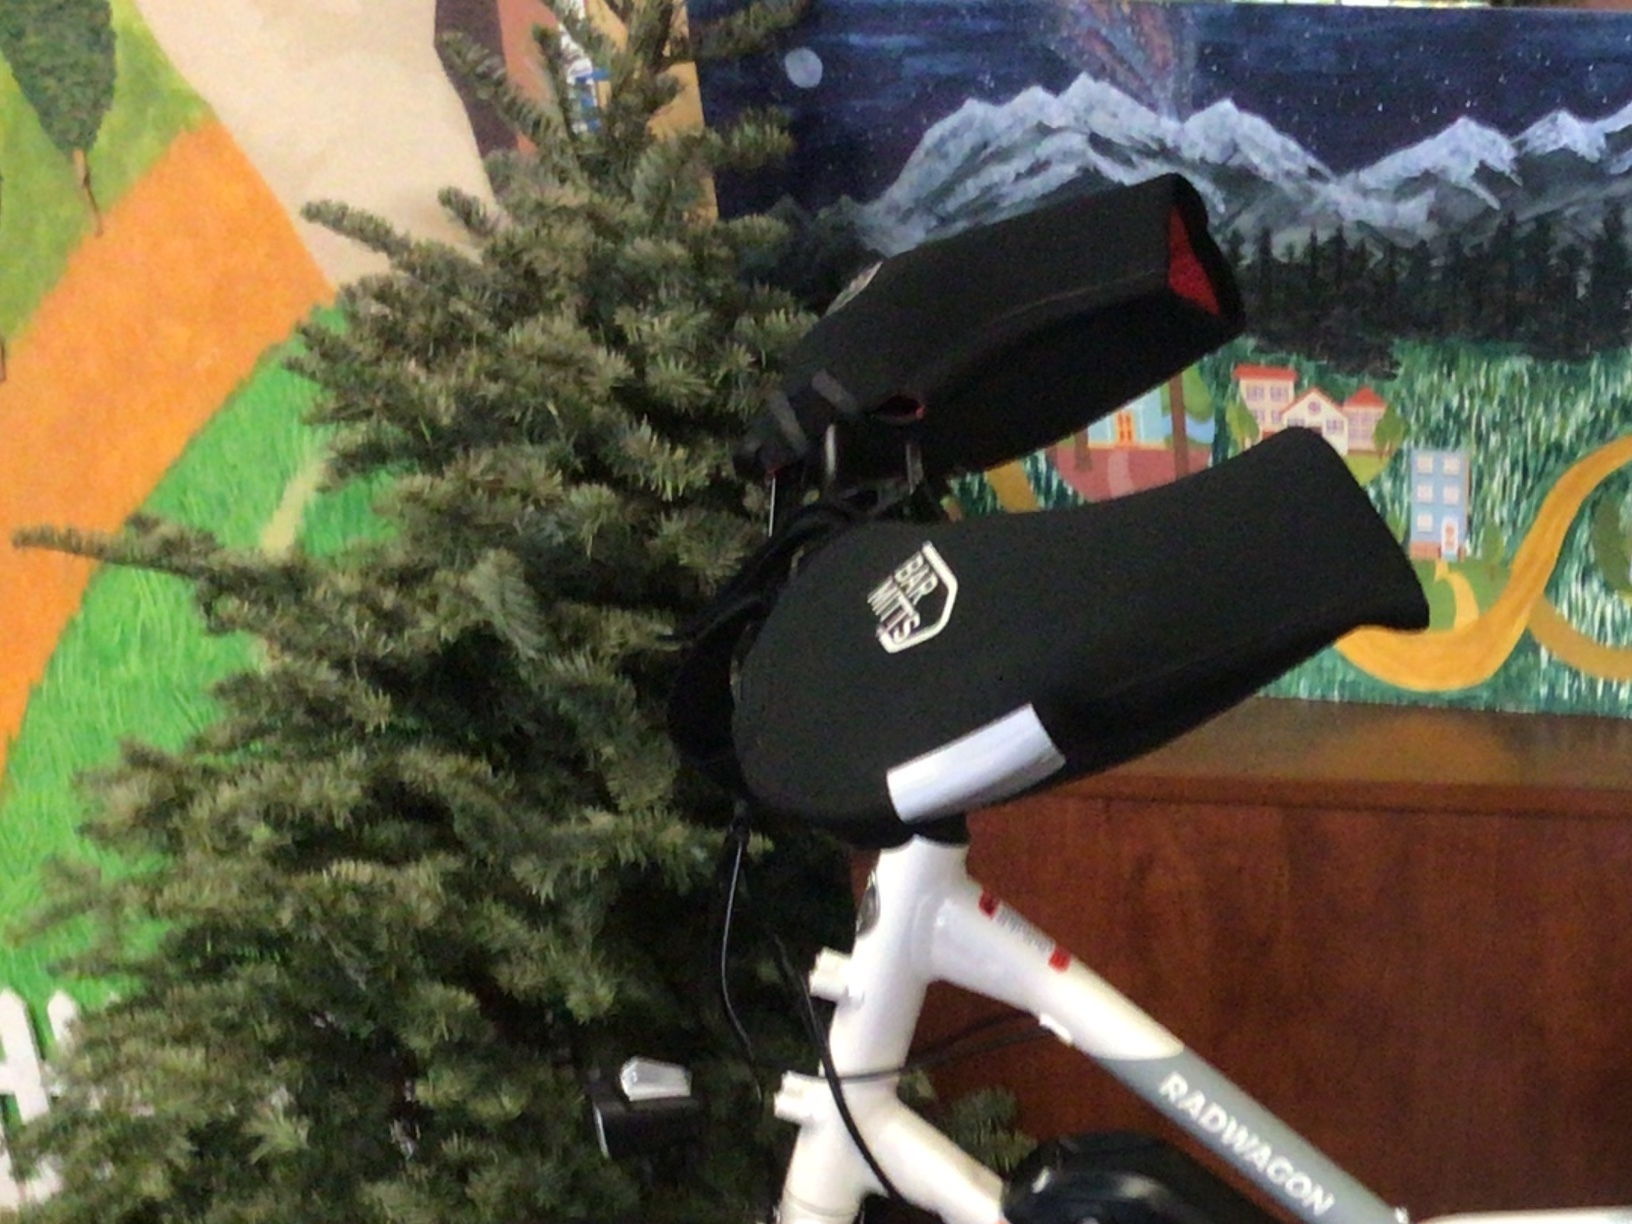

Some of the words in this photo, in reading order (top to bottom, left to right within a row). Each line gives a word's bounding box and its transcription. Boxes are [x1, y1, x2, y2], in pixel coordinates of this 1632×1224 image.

[867, 575, 921, 645] MITTS
[894, 550, 938, 606] BAR
[1158, 1071, 1335, 1217] RADWAGON
